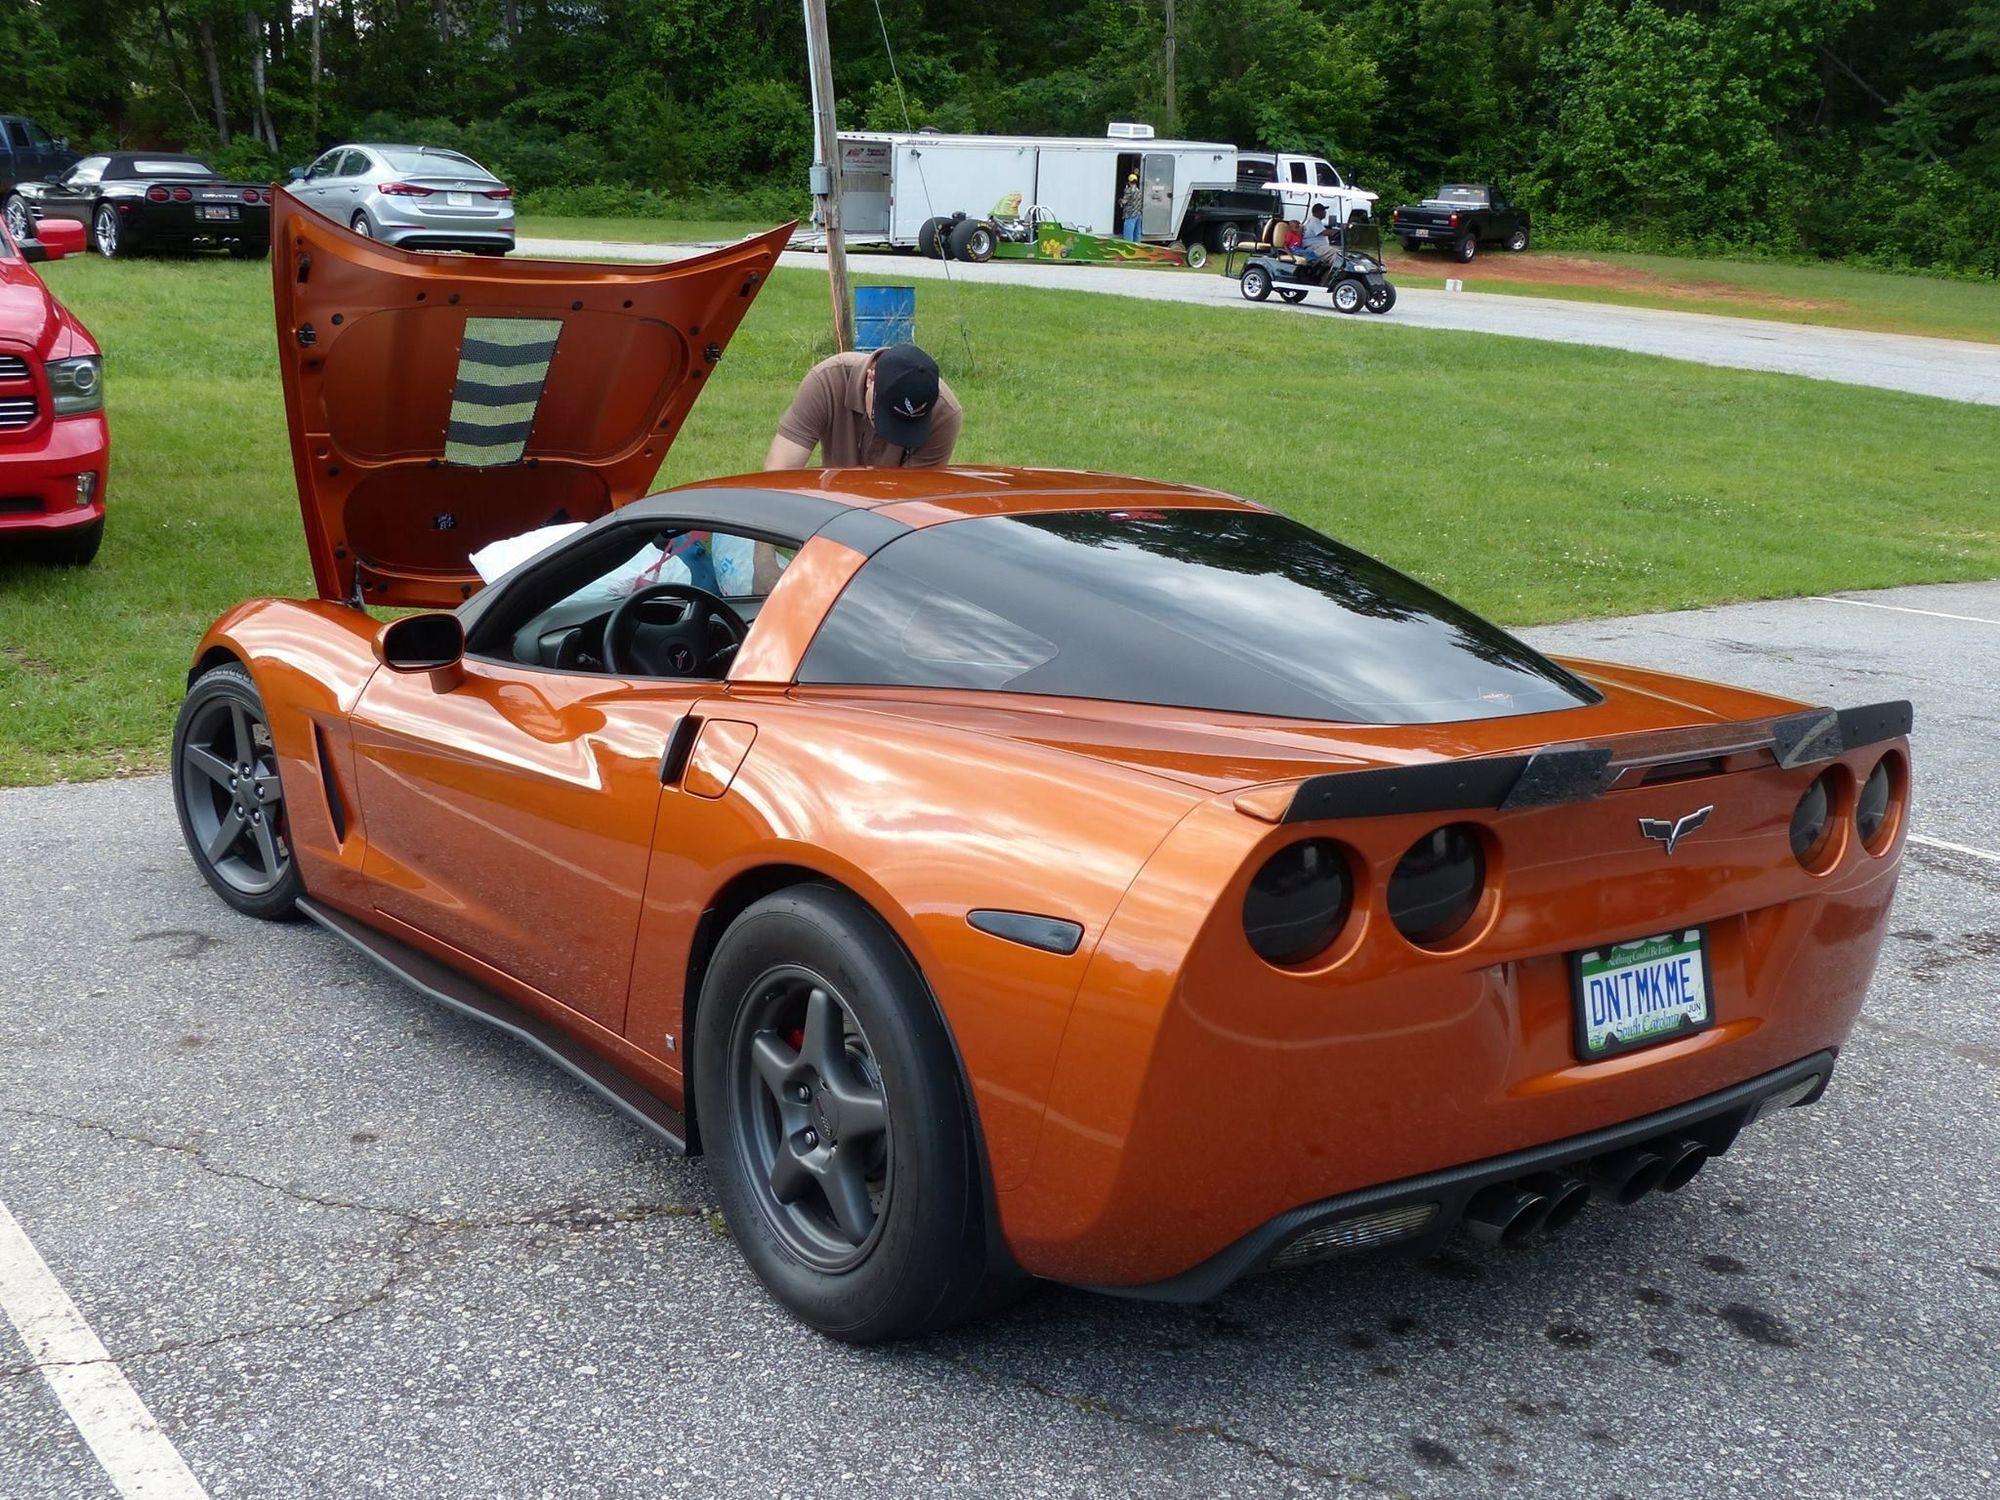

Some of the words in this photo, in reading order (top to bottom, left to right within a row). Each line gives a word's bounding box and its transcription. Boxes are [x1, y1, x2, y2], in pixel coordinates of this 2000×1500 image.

[1590, 957, 1694, 1027] DNTMKME
[1616, 1017, 1642, 1038] South
[1642, 1011, 1680, 1033] Carolina
